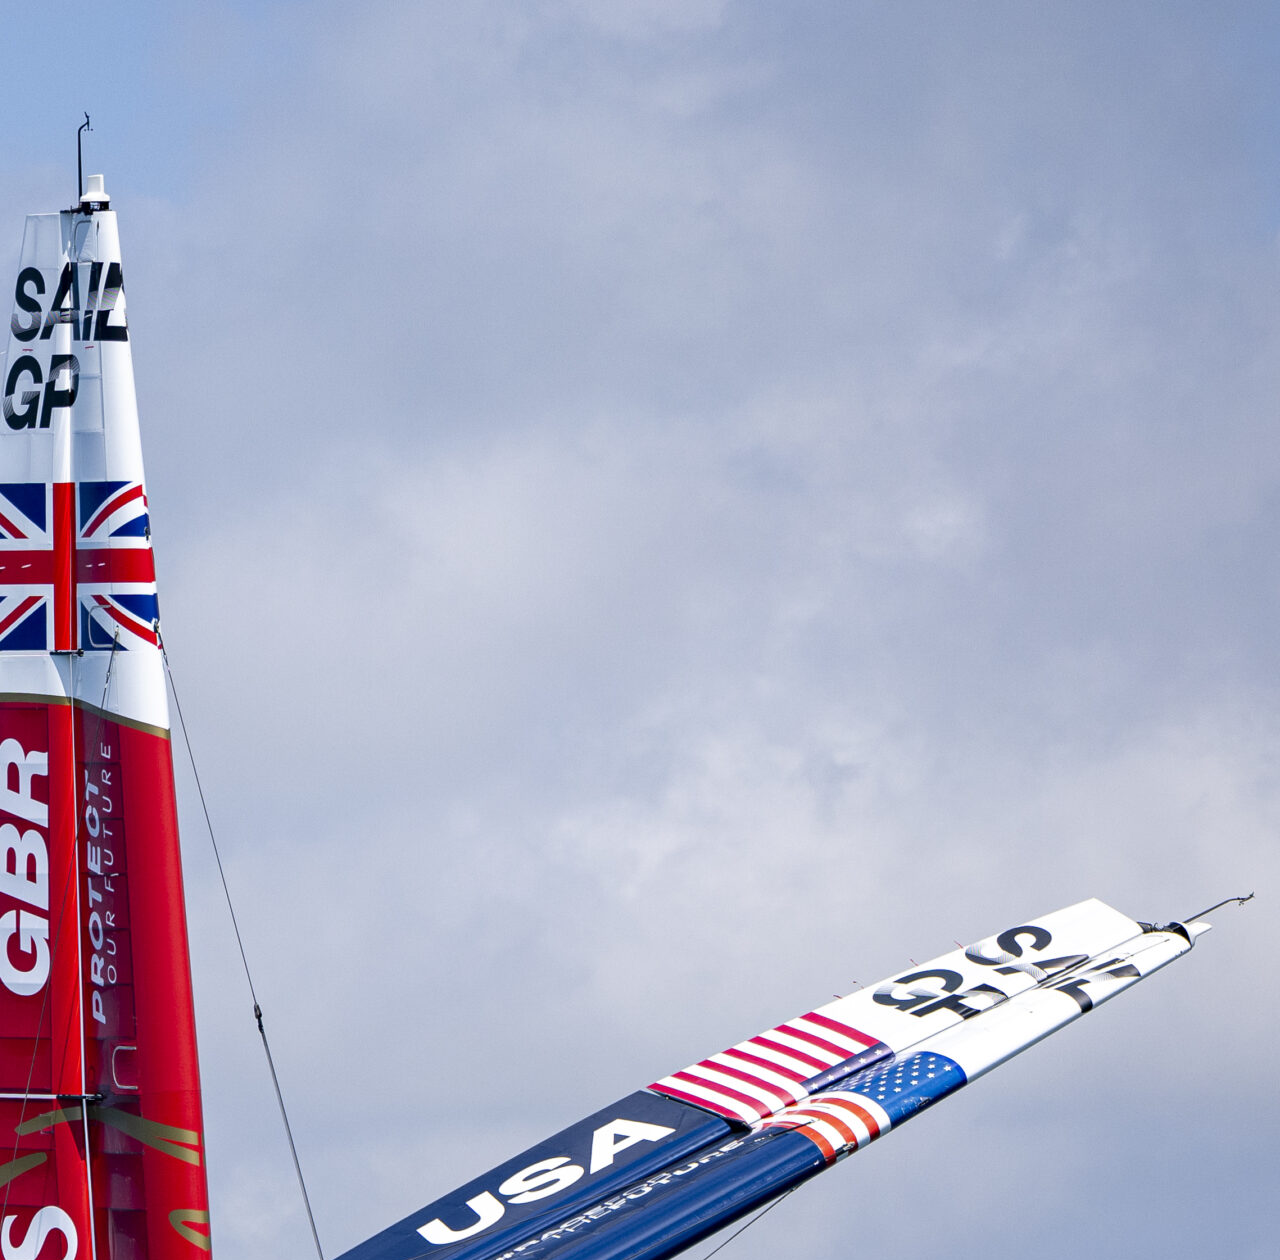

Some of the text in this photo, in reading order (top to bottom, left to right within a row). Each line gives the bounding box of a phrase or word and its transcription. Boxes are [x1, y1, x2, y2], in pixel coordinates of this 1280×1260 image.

[10, 261, 129, 342] SAIL
[2, 353, 81, 430] GP
[84, 769, 107, 1025] PROTECT
[101, 742, 117, 984] OUR FUTURE
[415, 1118, 676, 1245] USA
